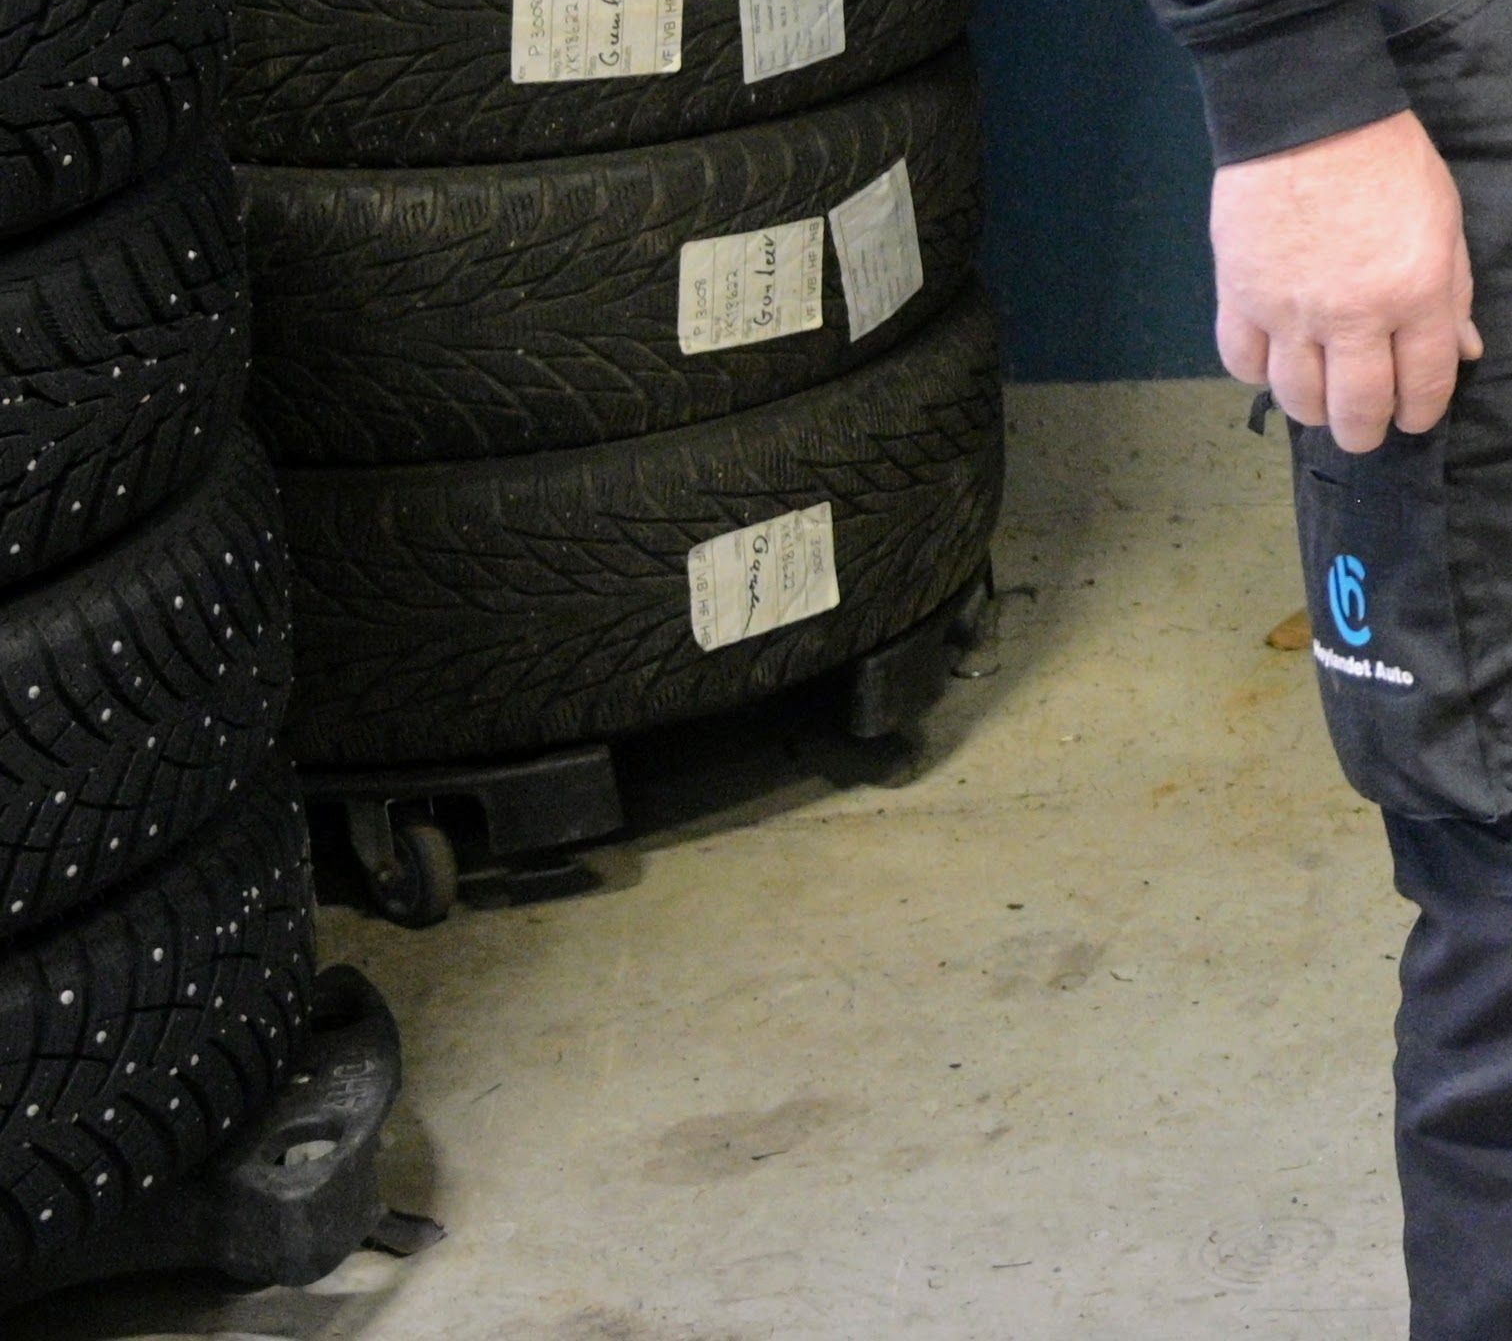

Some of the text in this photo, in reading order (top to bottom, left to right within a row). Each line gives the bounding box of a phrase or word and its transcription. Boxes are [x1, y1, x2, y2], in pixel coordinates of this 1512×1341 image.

[664, 20, 675, 38] VB
[808, 249, 816, 269] HF
[807, 277, 816, 295] VB
[696, 572, 708, 591] VB
[698, 598, 709, 616] HF
[1375, 660, 1414, 686] Auto
